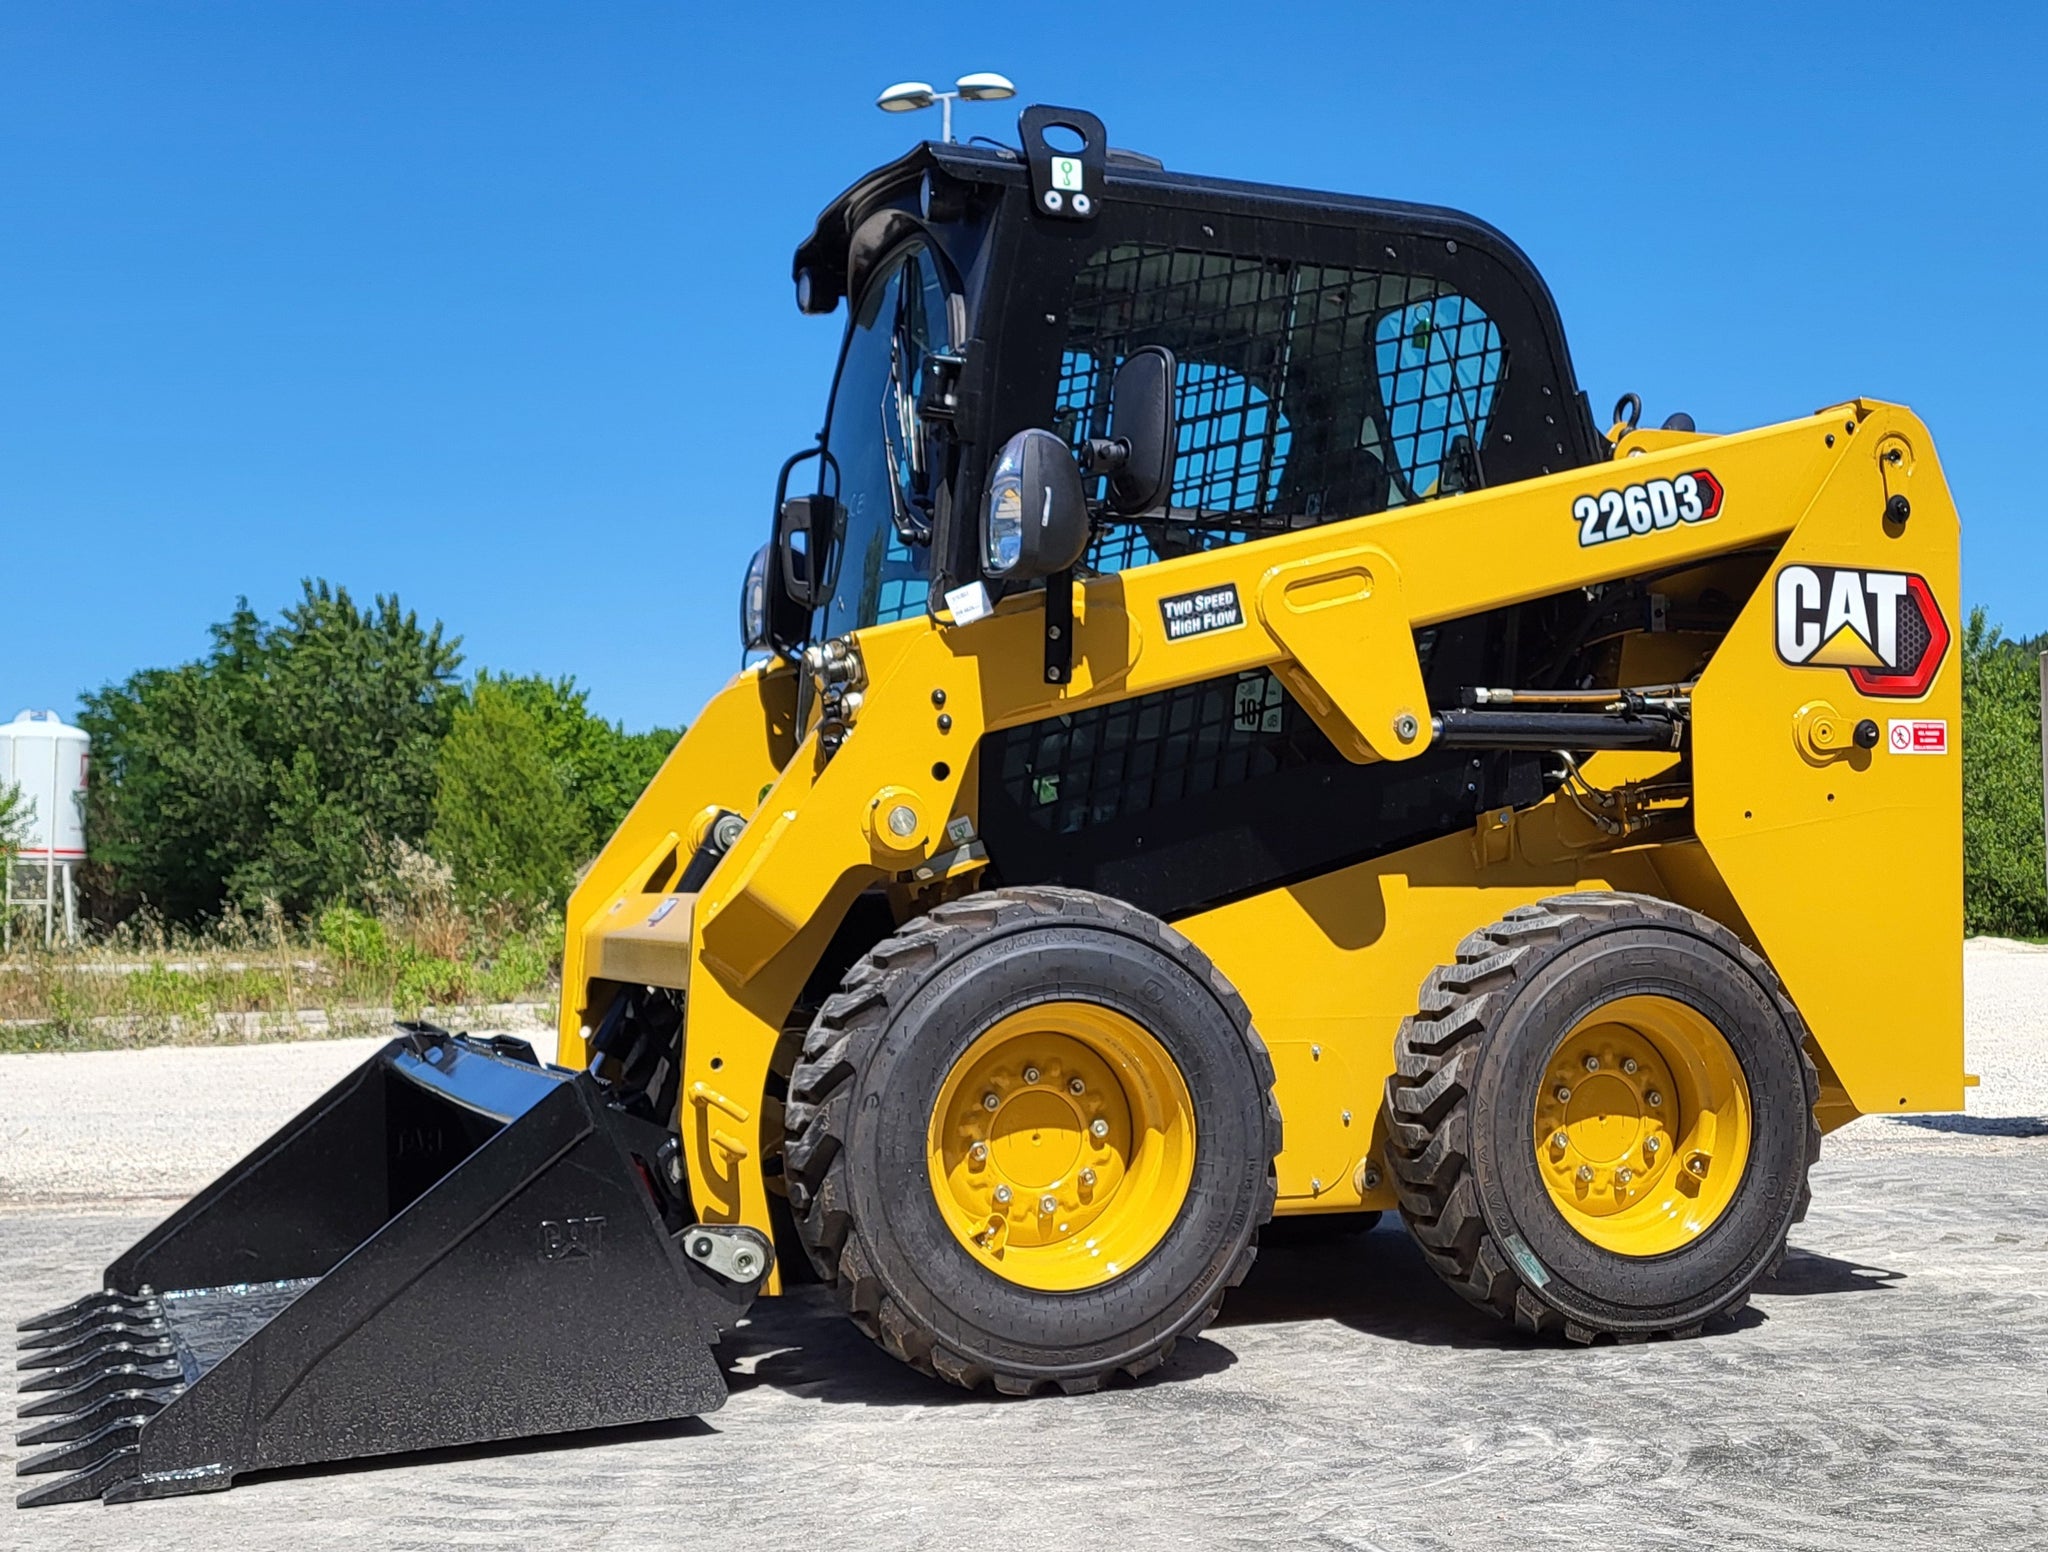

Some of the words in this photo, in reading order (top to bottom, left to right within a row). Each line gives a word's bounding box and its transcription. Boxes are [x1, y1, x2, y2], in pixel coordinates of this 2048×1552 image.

[1574, 474, 1703, 546] 226D3
[1777, 565, 1908, 668] CAT
[1476, 1096, 1510, 1231] GALAXY
[539, 1215, 608, 1262] CAT
